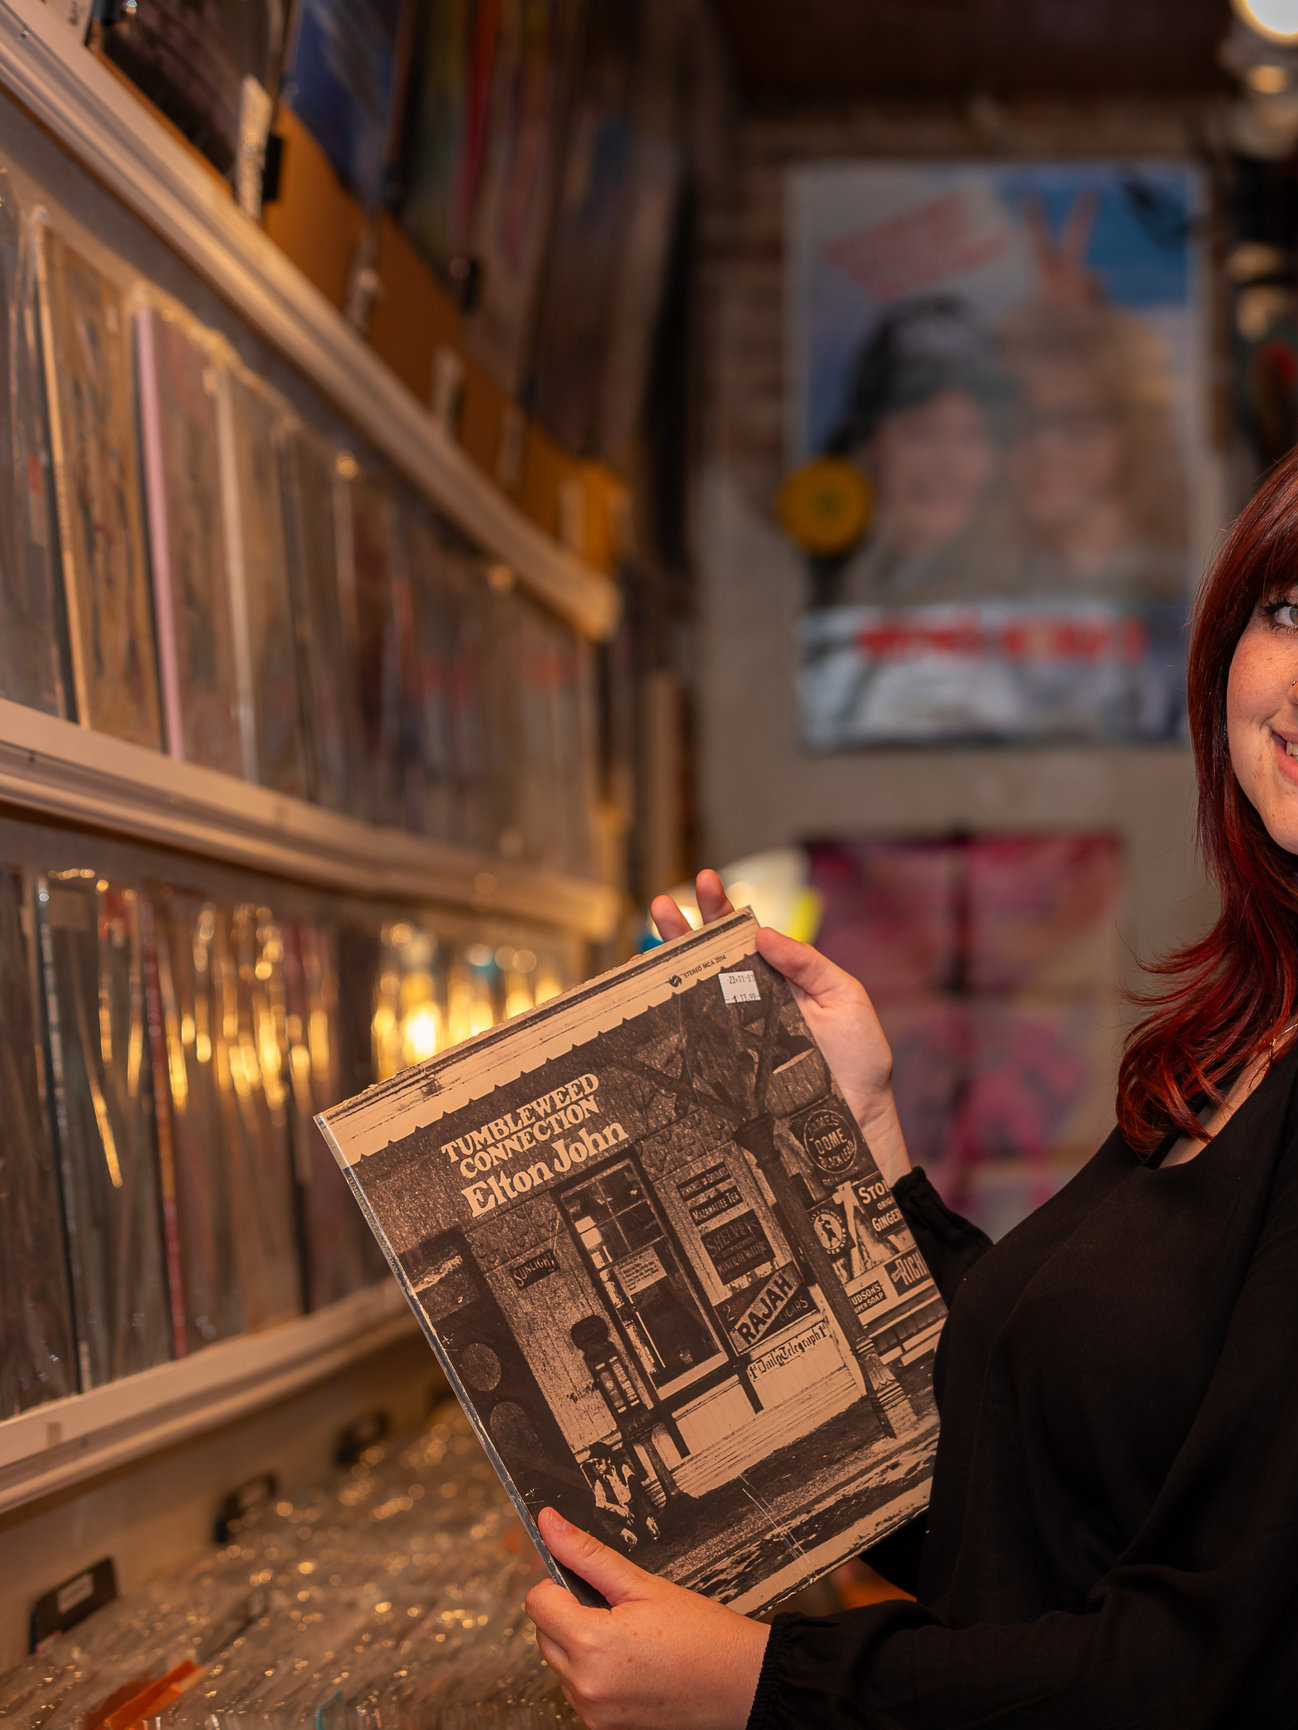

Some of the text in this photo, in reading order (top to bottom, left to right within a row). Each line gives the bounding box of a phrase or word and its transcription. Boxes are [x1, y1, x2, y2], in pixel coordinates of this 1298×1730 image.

[683, 965, 702, 978] STEREO
[702, 960, 715, 970] MCA
[441, 1073, 600, 1163] TUMBLEWEED
[460, 1095, 600, 1179] CONNECTION
[814, 1128, 847, 1154] DOME
[461, 1122, 629, 1218] Elton John
[872, 1208, 903, 1232] GINGER
[851, 1283, 881, 1305] UDSON'S
[866, 1292, 884, 1308] SOAP
[756, 1352, 785, 1375] Daily
[780, 1329, 821, 1361] Telegraph
